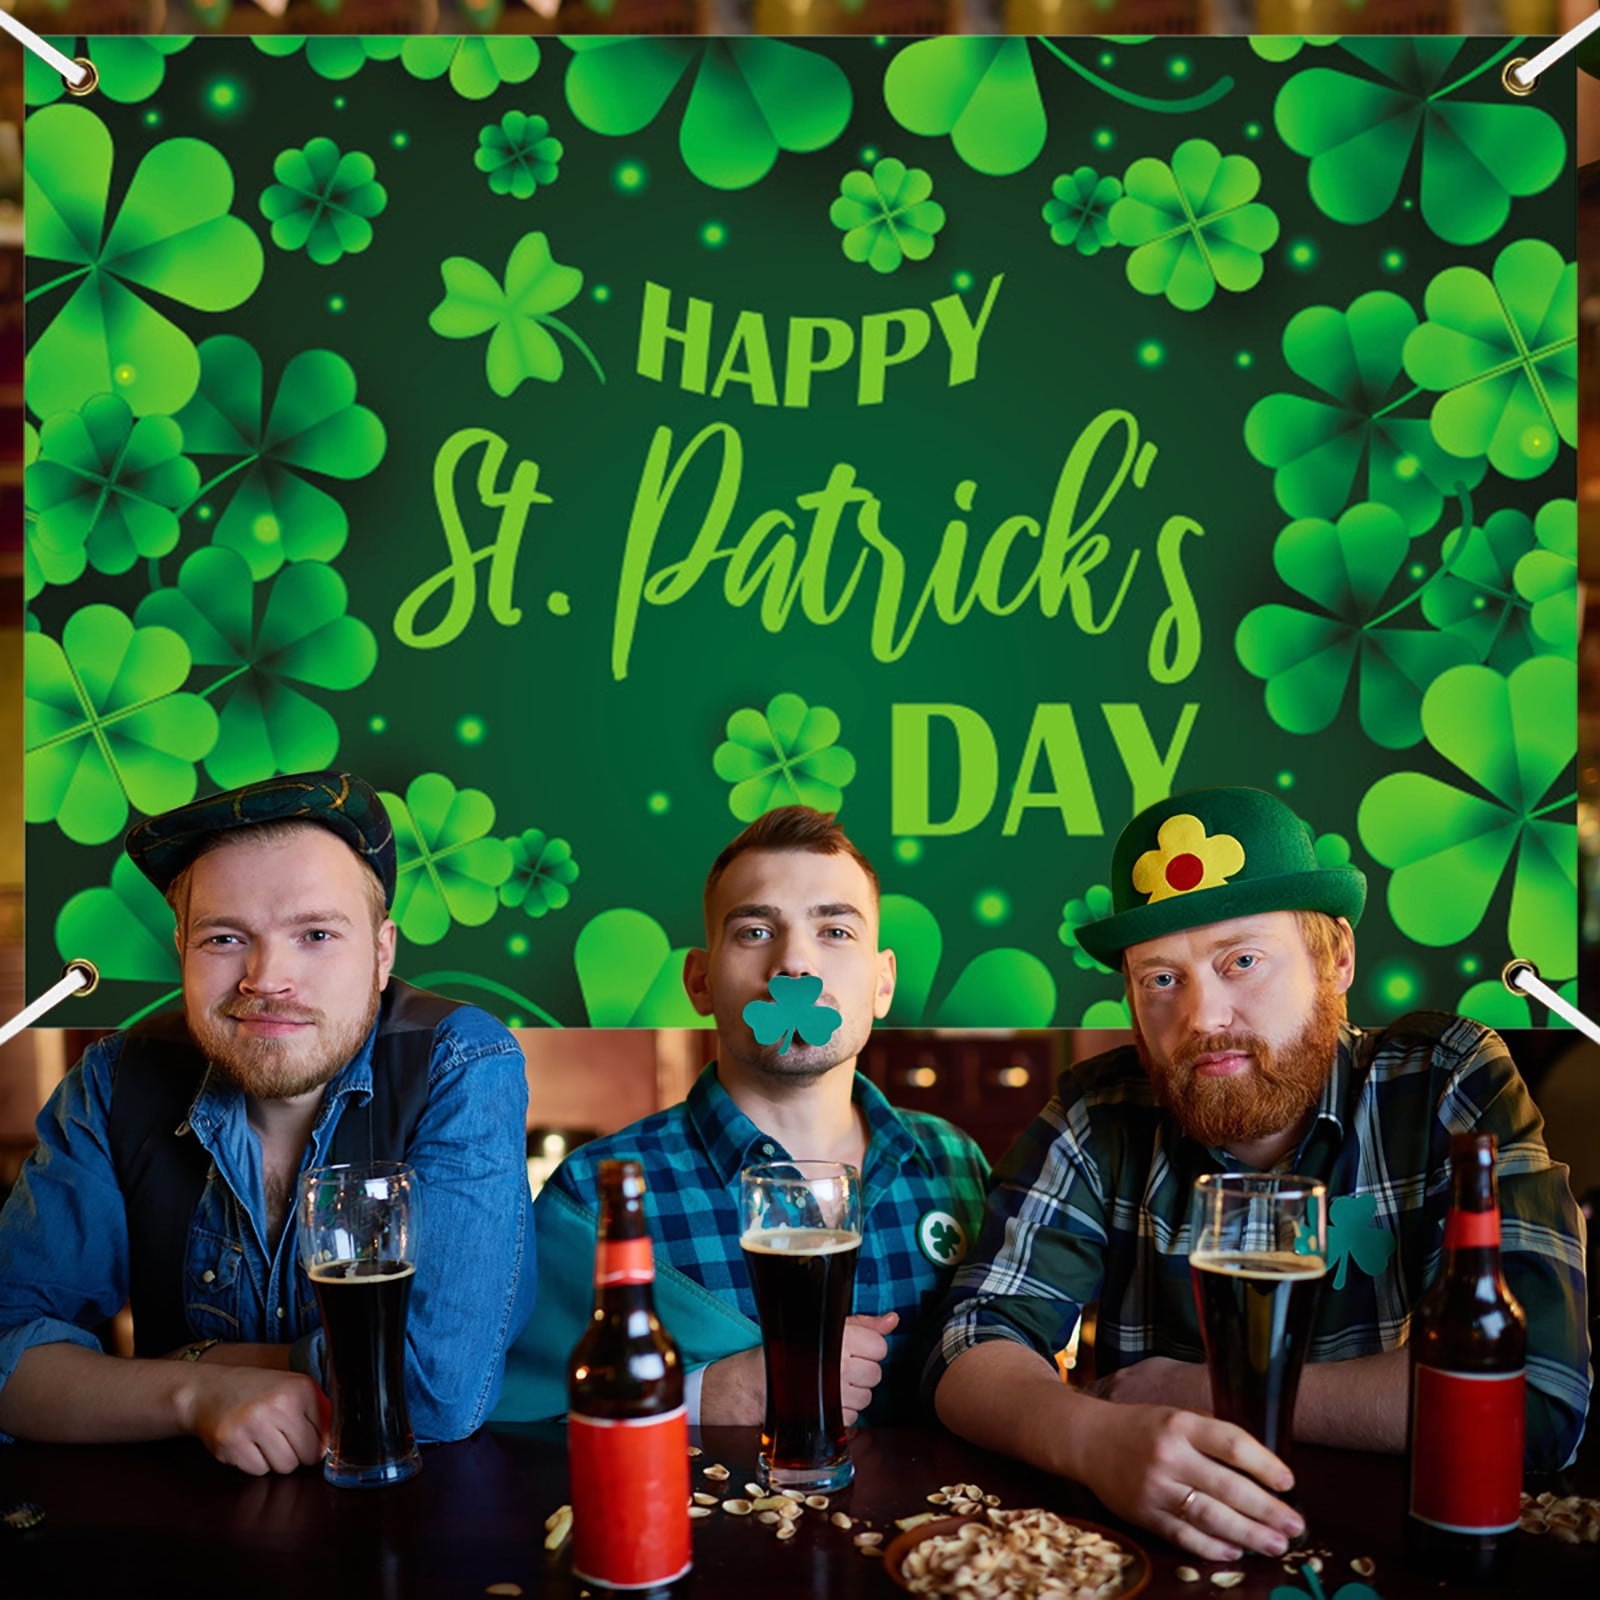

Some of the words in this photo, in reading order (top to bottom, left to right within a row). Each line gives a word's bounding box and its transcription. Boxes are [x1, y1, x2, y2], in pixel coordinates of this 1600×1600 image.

[636, 273, 1004, 407] HAPPY
[394, 428, 570, 649] St.
[612, 408, 1205, 684] Patrick's
[891, 703, 1200, 836] DAY
